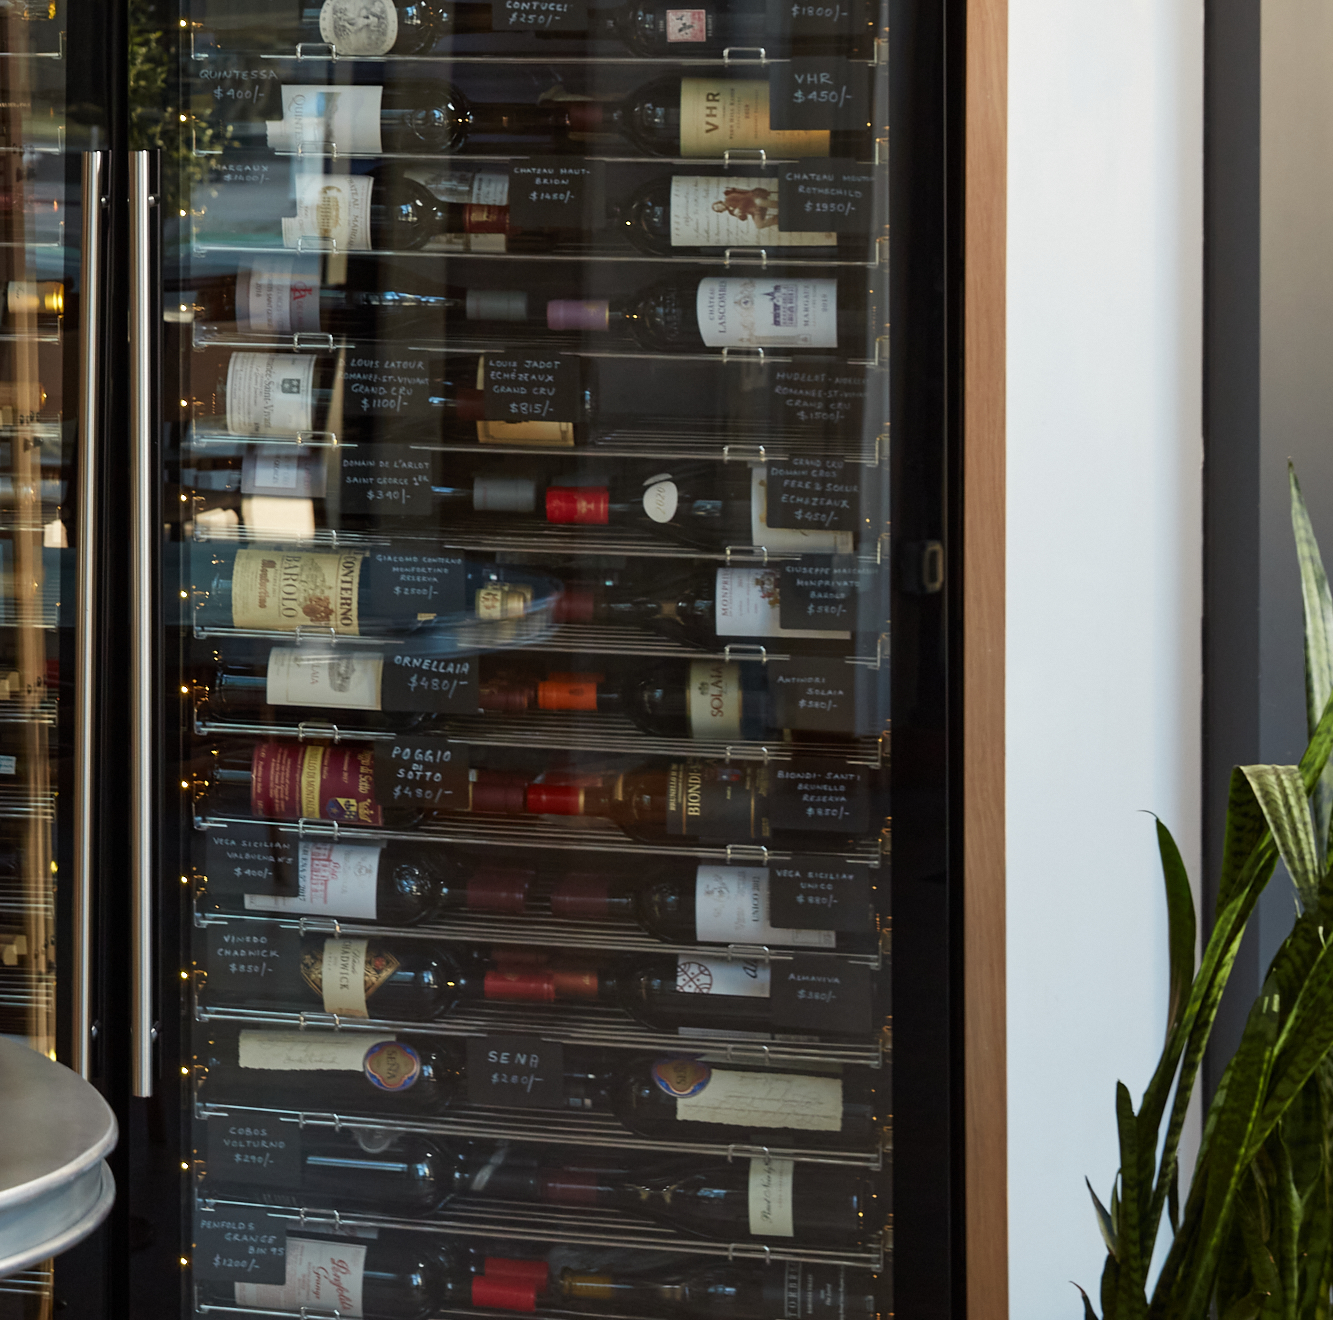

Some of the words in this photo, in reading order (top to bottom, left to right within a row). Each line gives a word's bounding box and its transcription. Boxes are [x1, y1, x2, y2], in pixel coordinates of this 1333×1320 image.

[199, 68, 279, 81] QUINTESSA
[794, 73, 834, 85] VHR
[705, 90, 721, 134] VHR
[383, 360, 425, 370] LATOUR
[523, 360, 561, 370] JADOT
[493, 384, 528, 396] GRAND
[532, 386, 556, 396] CRU
[508, 400, 554, 417] $815/-
[375, 554, 419, 564] GIACOMO
[281, 555, 302, 619] BAROLO
[339, 557, 356, 628] CONTERNO
[393, 655, 471, 676] ORNELLAIA
[710, 665, 725, 718] SOLAIA
[391, 746, 452, 763] POGGIO
[396, 768, 442, 782] SOTTO
[212, 837, 237, 847] VEGA
[217, 948, 280, 959] CHADWICK
[487, 1050, 540, 1068] SENA
[229, 1126, 268, 1137] COBOS
[223, 1138, 286, 1150] VOLTURNO
[200, 1219, 255, 1231] PENFOLDS
[224, 1233, 277, 1244] GRANGE
[247, 1244, 268, 1255] BIN
